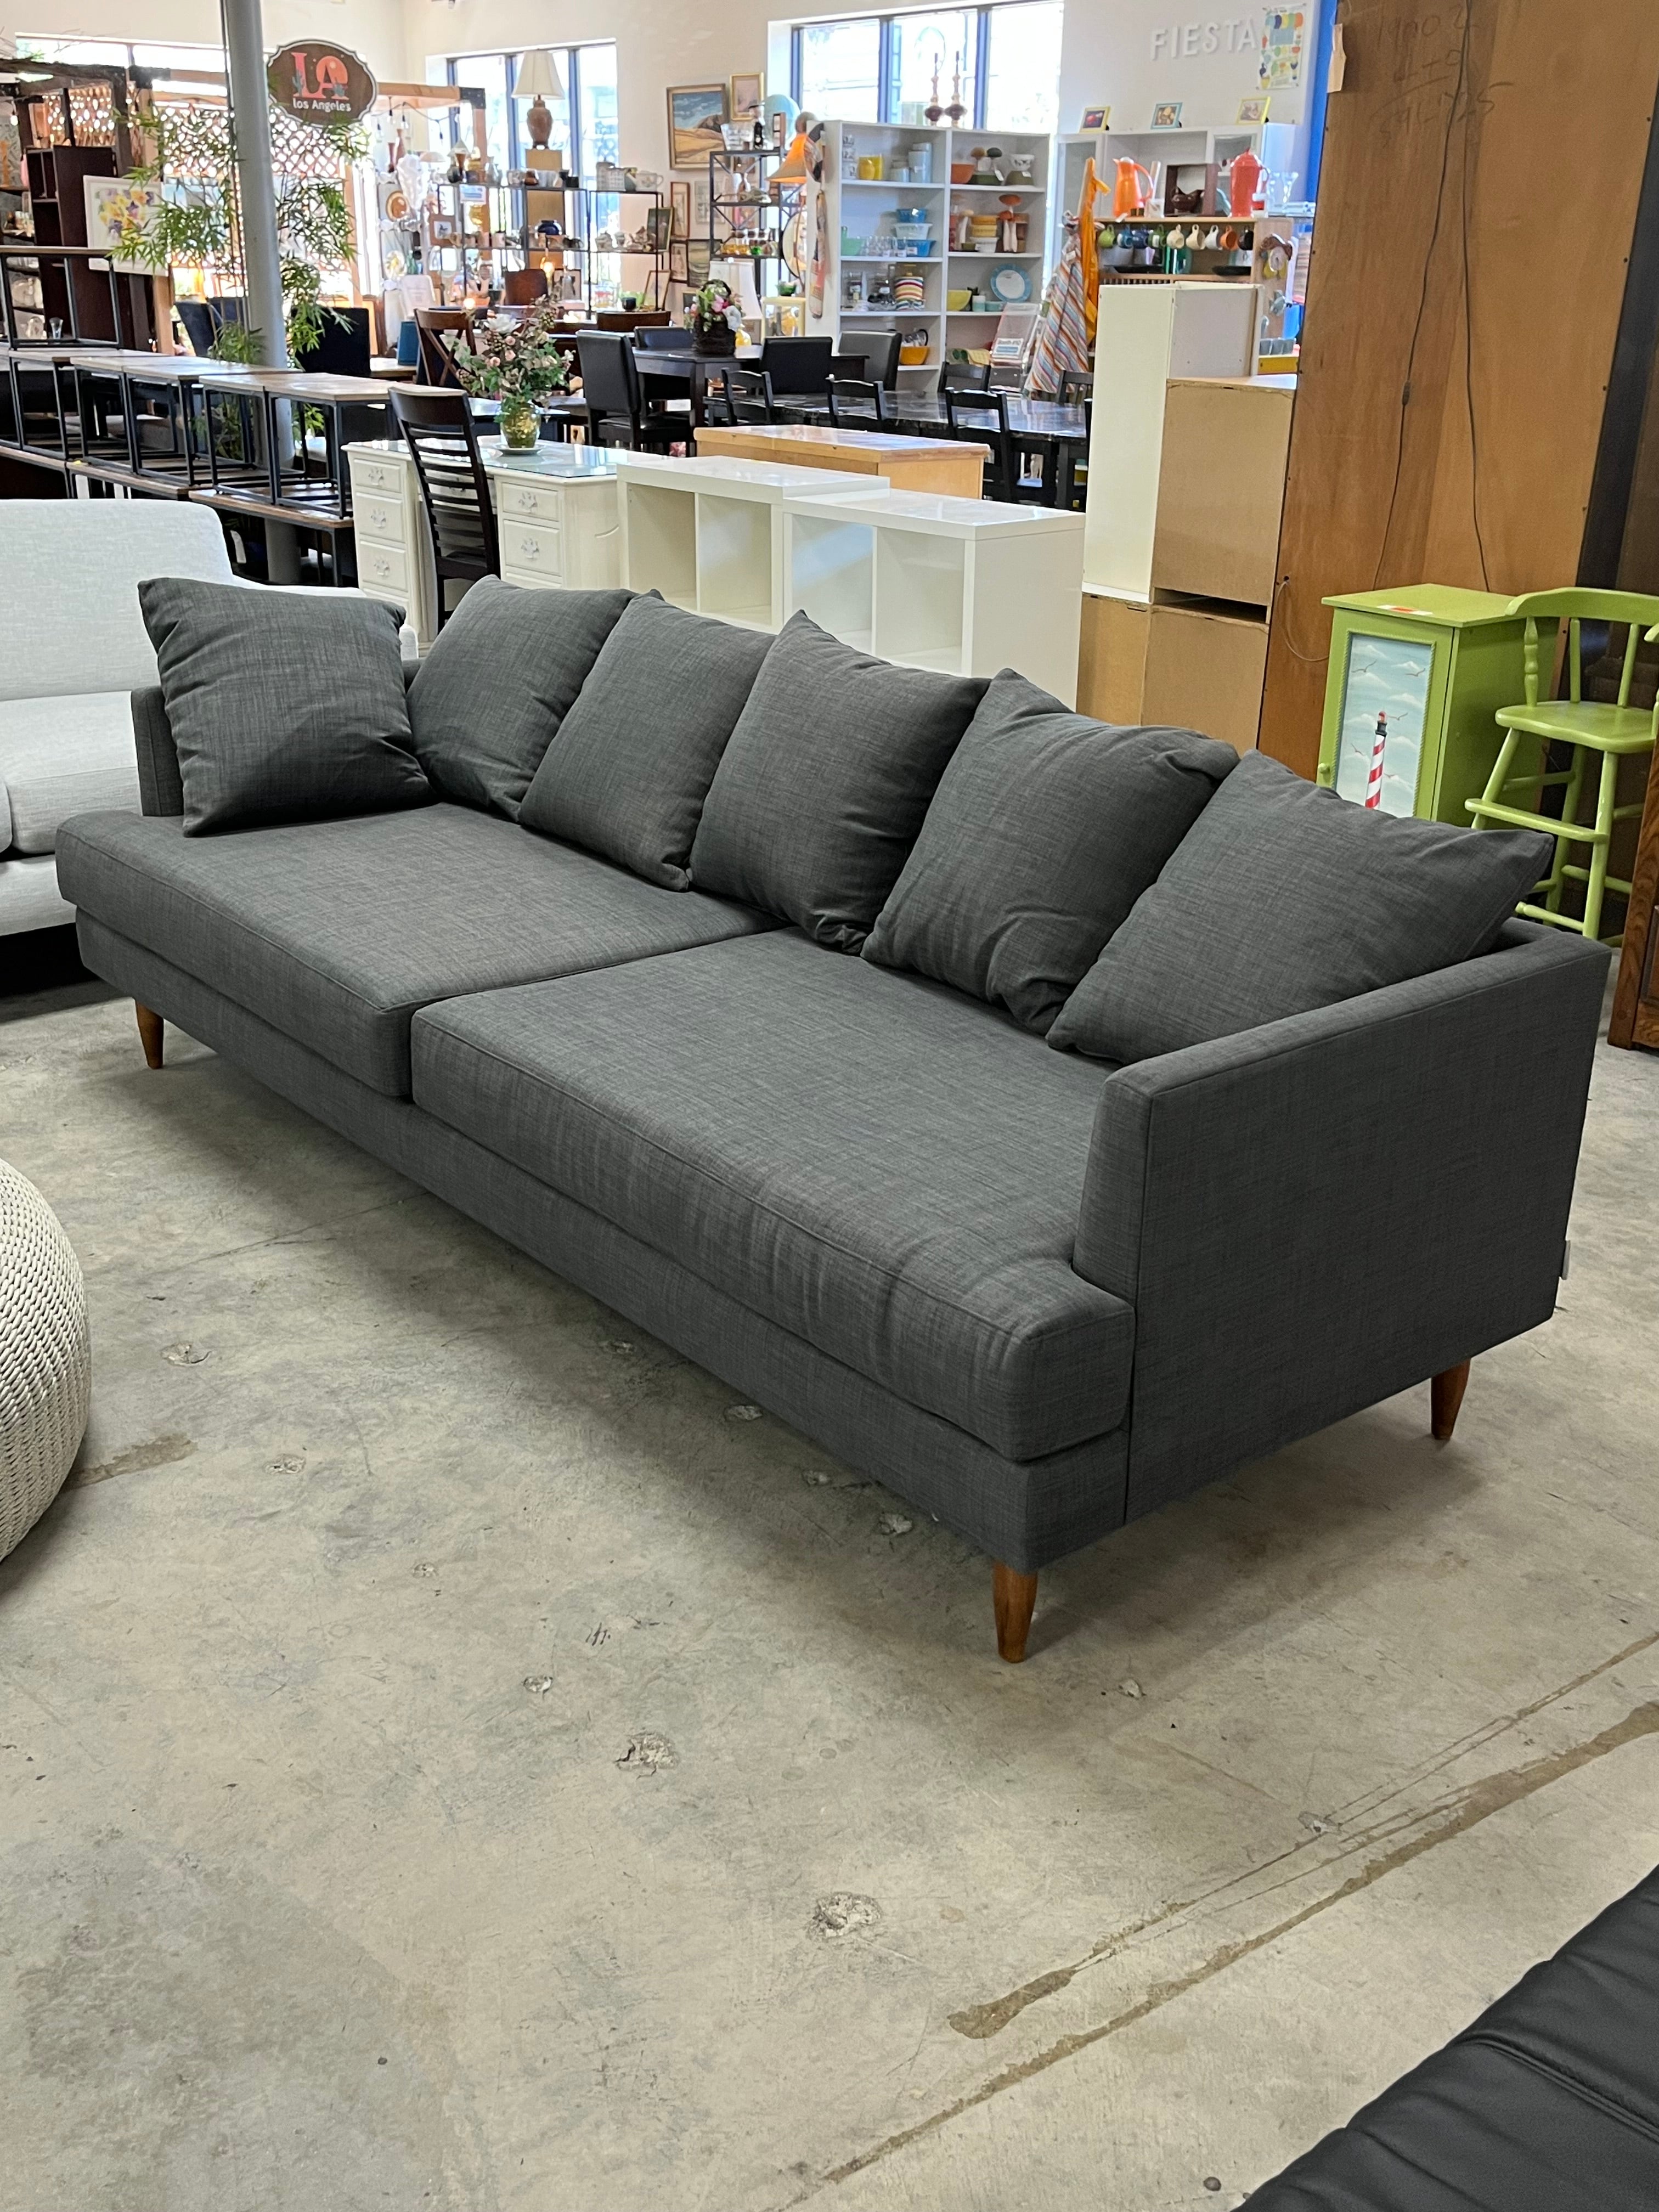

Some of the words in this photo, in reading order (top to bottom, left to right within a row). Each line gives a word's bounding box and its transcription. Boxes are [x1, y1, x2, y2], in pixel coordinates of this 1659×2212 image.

[1152, 19, 1257, 60] FIESTA
[291, 52, 349, 99] LA
[312, 100, 351, 112] Angeles
